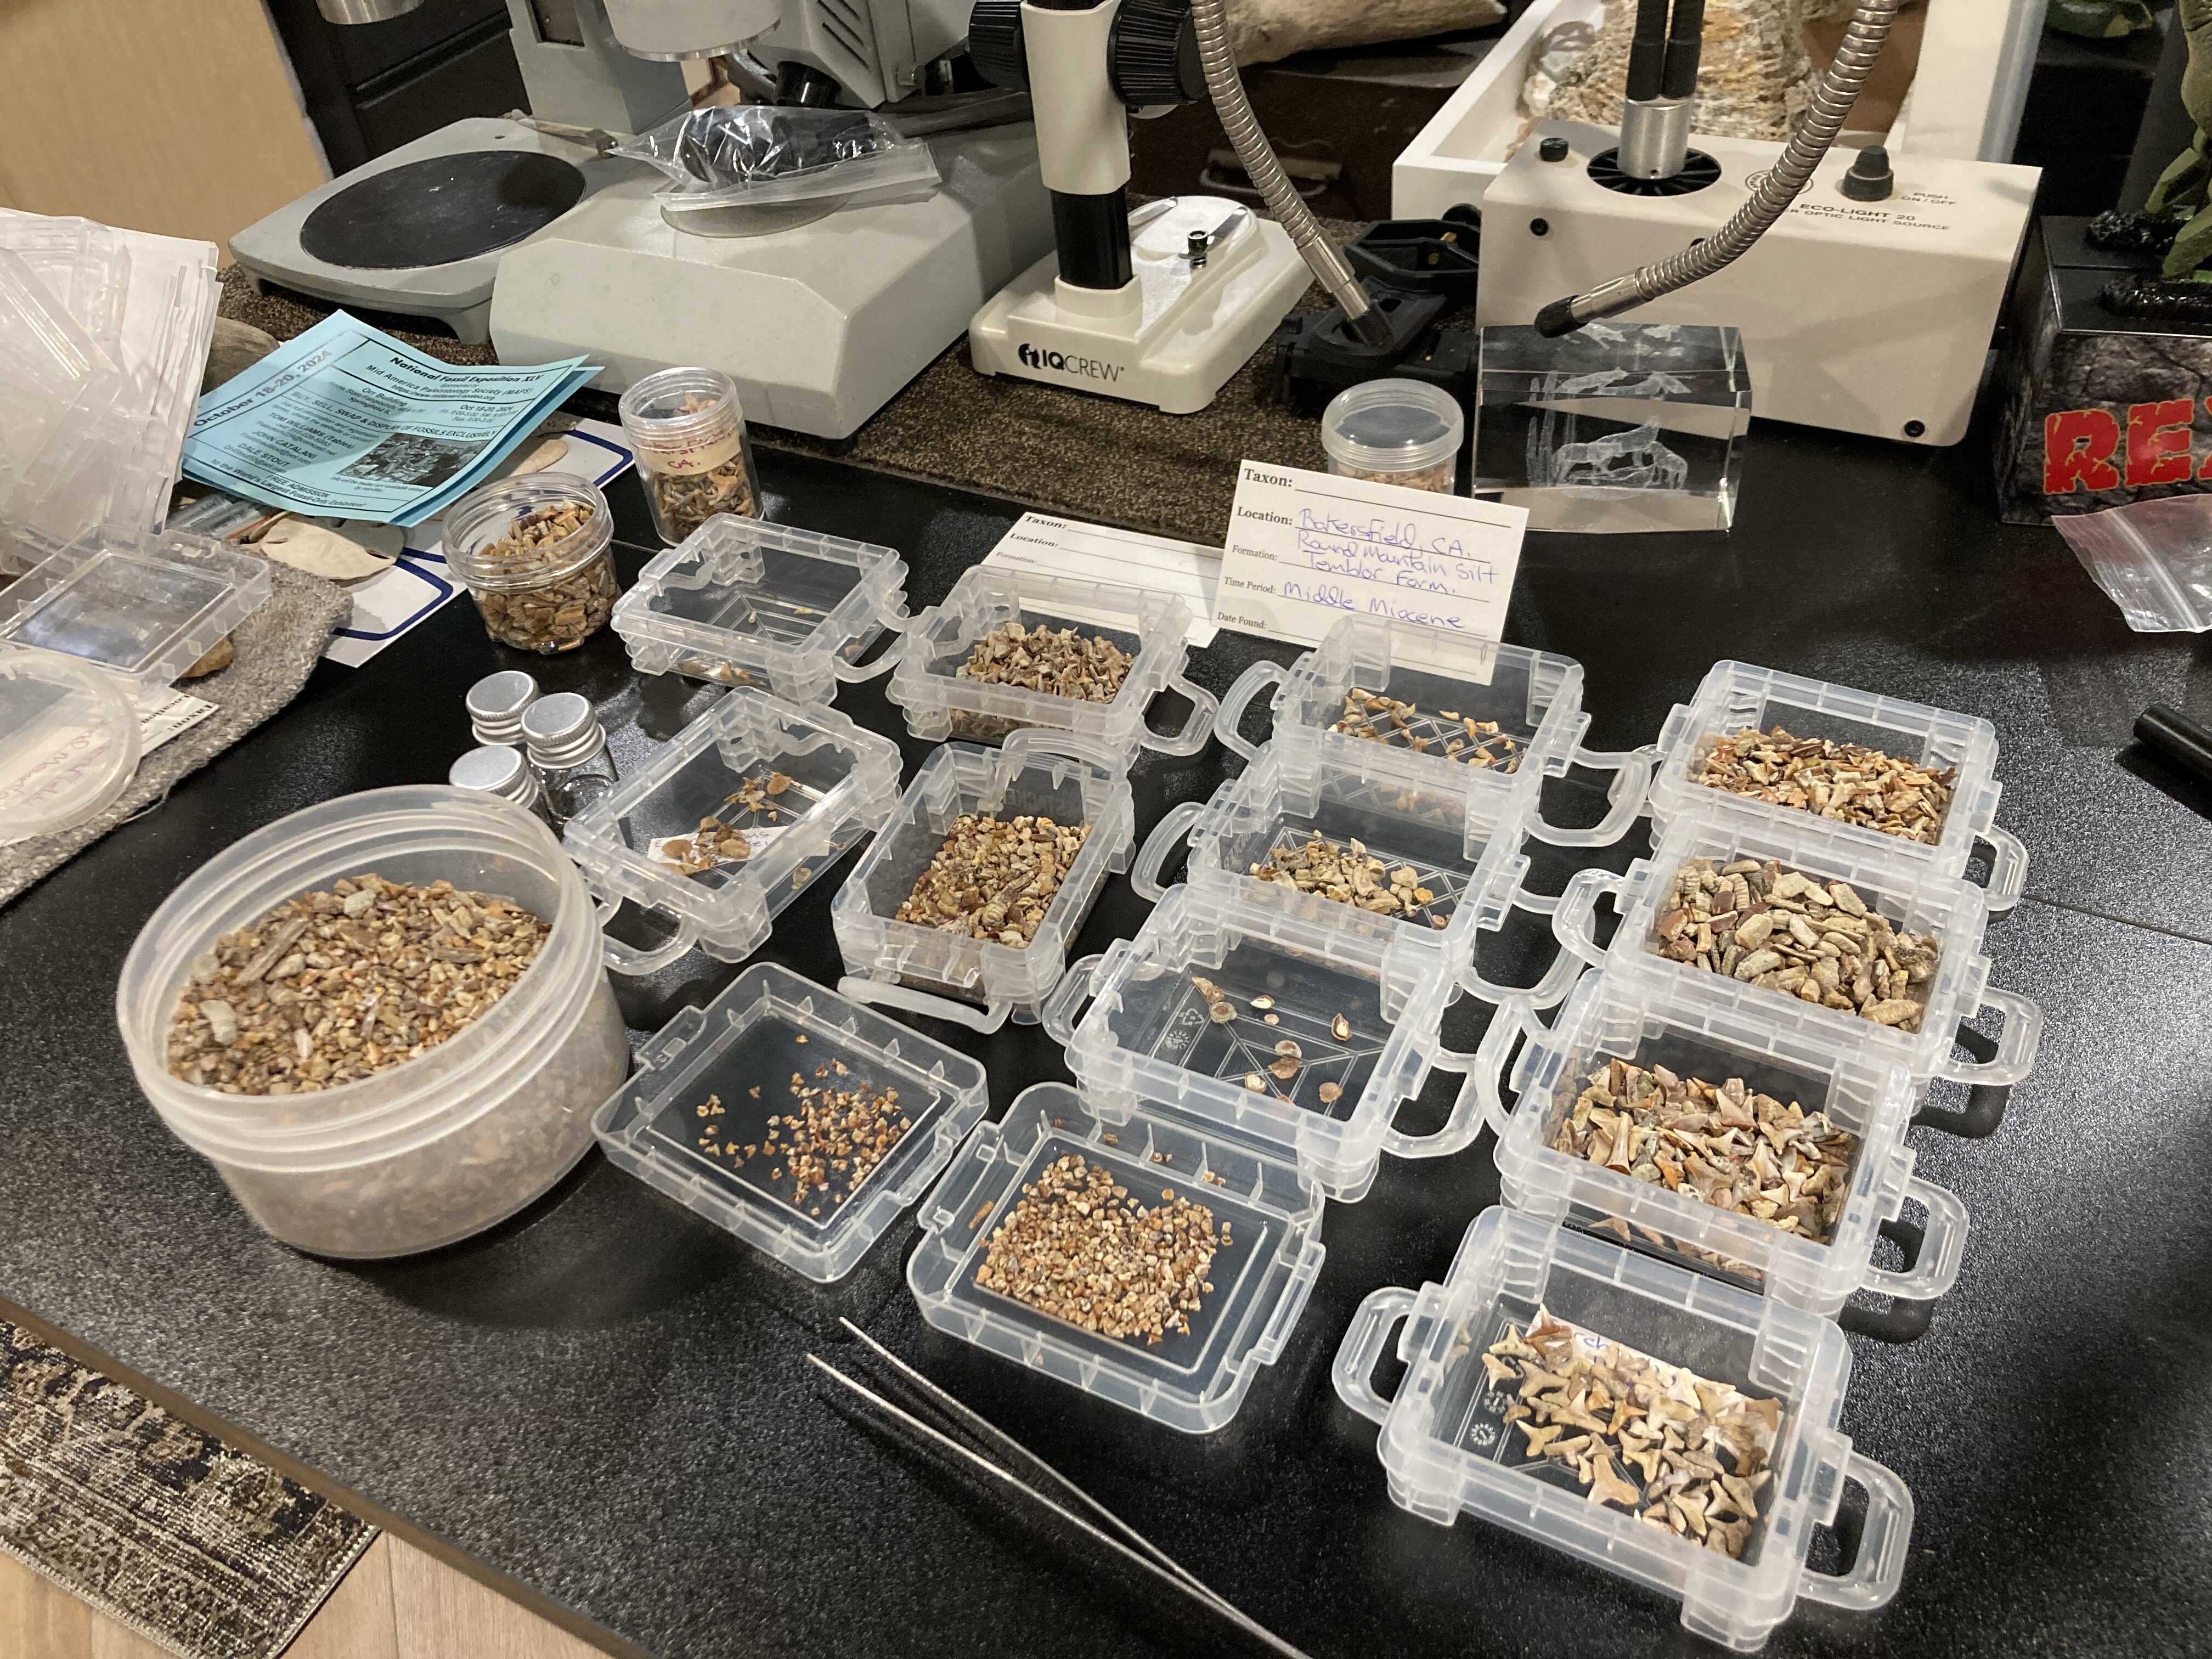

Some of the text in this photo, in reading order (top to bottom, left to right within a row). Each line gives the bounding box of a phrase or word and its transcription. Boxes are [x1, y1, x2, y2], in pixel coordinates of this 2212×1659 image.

[1799, 204, 1891, 218] ECO-LIGHT
[1805, 210, 1843, 218] OPTIC
[1848, 215, 1886, 224] LIGHT
[1893, 221, 1951, 230] SOURCE
[390, 357, 442, 380] National
[194, 351, 332, 426] October 18-20, 2024
[366, 365, 385, 375] Mid
[384, 374, 420, 390] America
[502, 387, 533, 396] (MAPS)
[348, 397, 385, 412] Springfield
[376, 393, 408, 407] Building
[291, 391, 311, 403] BUY,
[335, 409, 362, 420] SWAP
[368, 421, 402, 430] DISPLAY
[412, 426, 447, 436] FOSSILS
[268, 412, 289, 421] TOM
[286, 419, 326, 437] WILLIAMS
[323, 436, 356, 449] (Tables)
[238, 443, 291, 466] DALE STOUT
[252, 431, 276, 441] JOHN
[275, 439, 318, 459] CATALANI
[233, 468, 261, 482] World's
[261, 480, 290, 494] Largest
[266, 475, 289, 485] FREE
[287, 483, 331, 498] ADMISSION
[1244, 469, 1293, 487] Taxon:
[1025, 515, 1067, 529] Taxon:
[1237, 506, 1293, 526] Location:
[1009, 533, 1059, 548] Location:
[996, 551, 1037, 564] Formation:
[1232, 545, 1278, 561] Formation:
[1304, 550, 1456, 594] Temblor Form.
[1364, 546, 1446, 576] Mountain
[1455, 563, 1499, 584] Silt
[1224, 577, 1276, 594] Time Period:
[1284, 582, 1465, 628] Middle Miocene
[1217, 612, 1267, 629] Date Found:
[167, 704, 215, 730] Taxon:
